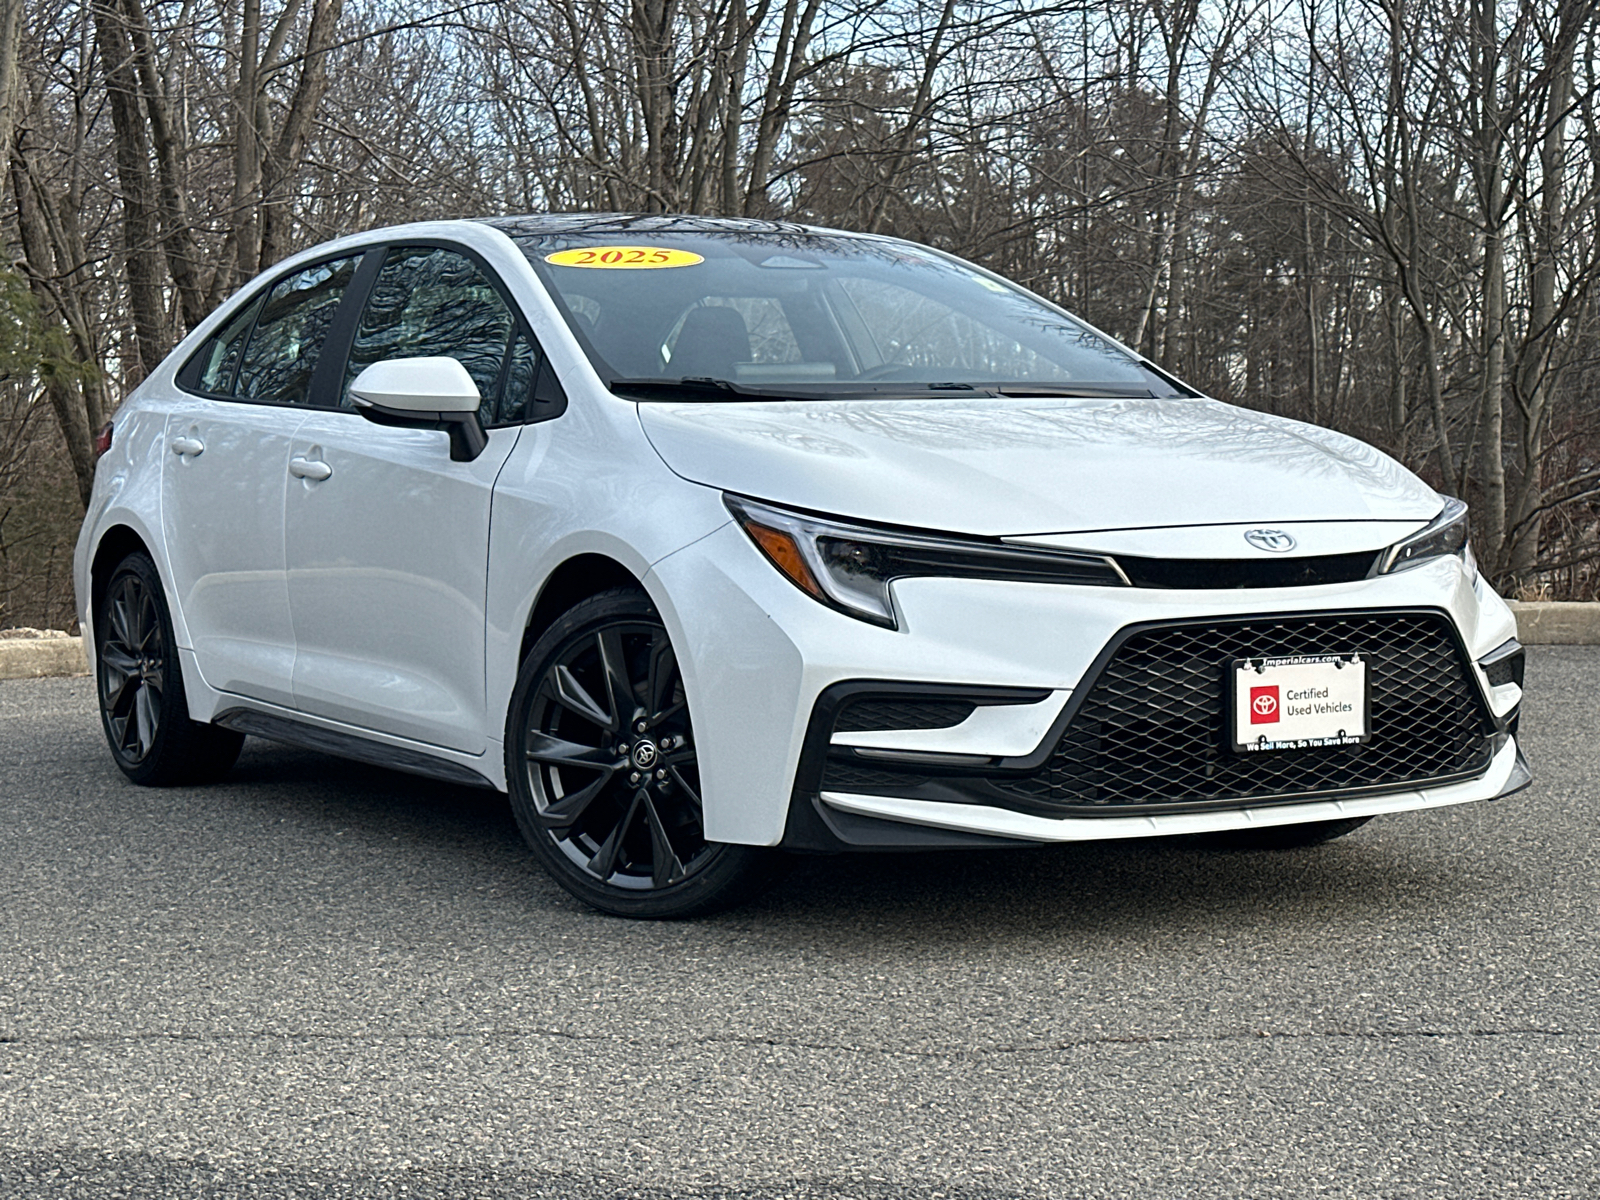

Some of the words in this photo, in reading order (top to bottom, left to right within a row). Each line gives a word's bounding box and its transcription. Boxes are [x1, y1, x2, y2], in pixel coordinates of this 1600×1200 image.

[574, 250, 671, 264] 2025
[1287, 687, 1329, 700] Certified
[1287, 704, 1312, 716] Used
[1314, 702, 1352, 714] Vehicles
[1247, 743, 1259, 751] We
[1260, 742, 1274, 751] Sell
[1276, 741, 1296, 749] More,
[1298, 739, 1307, 748] So
[1309, 738, 1322, 746] You
[1324, 737, 1341, 745] Save
[1342, 736, 1360, 744] More
